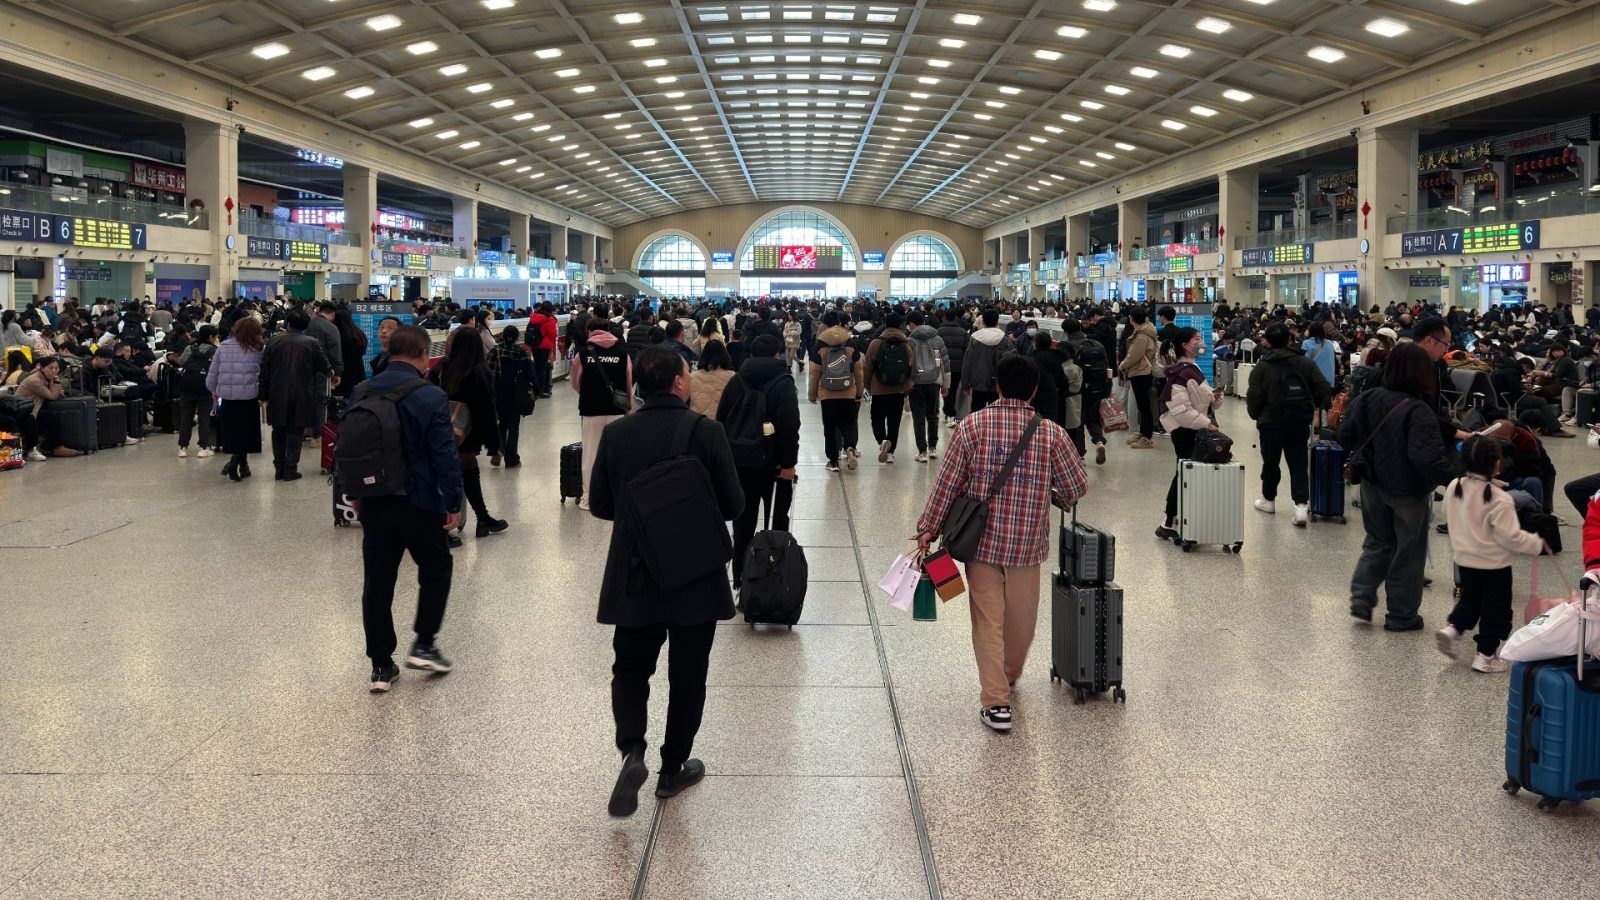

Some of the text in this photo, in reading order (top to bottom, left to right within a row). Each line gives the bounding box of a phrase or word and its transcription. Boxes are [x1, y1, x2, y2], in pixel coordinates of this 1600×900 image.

[2, 214, 30, 229] 检票口
[40, 219, 50, 237] B
[61, 221, 70, 239] 6
[135, 228, 143, 245] 7
[1414, 236, 1432, 247] 检票口
[1438, 236, 1447, 250] A
[1451, 233, 1459, 249] 7
[1525, 226, 1533, 244] 6
[274, 244, 280, 255] B
[285, 245, 290, 256] 8
[322, 248, 327, 259] 9
[1261, 251, 1267, 264] A
[1268, 250, 1273, 262] 9
[1305, 246, 1310, 259] 8
[356, 304, 393, 312] B2 候车区
